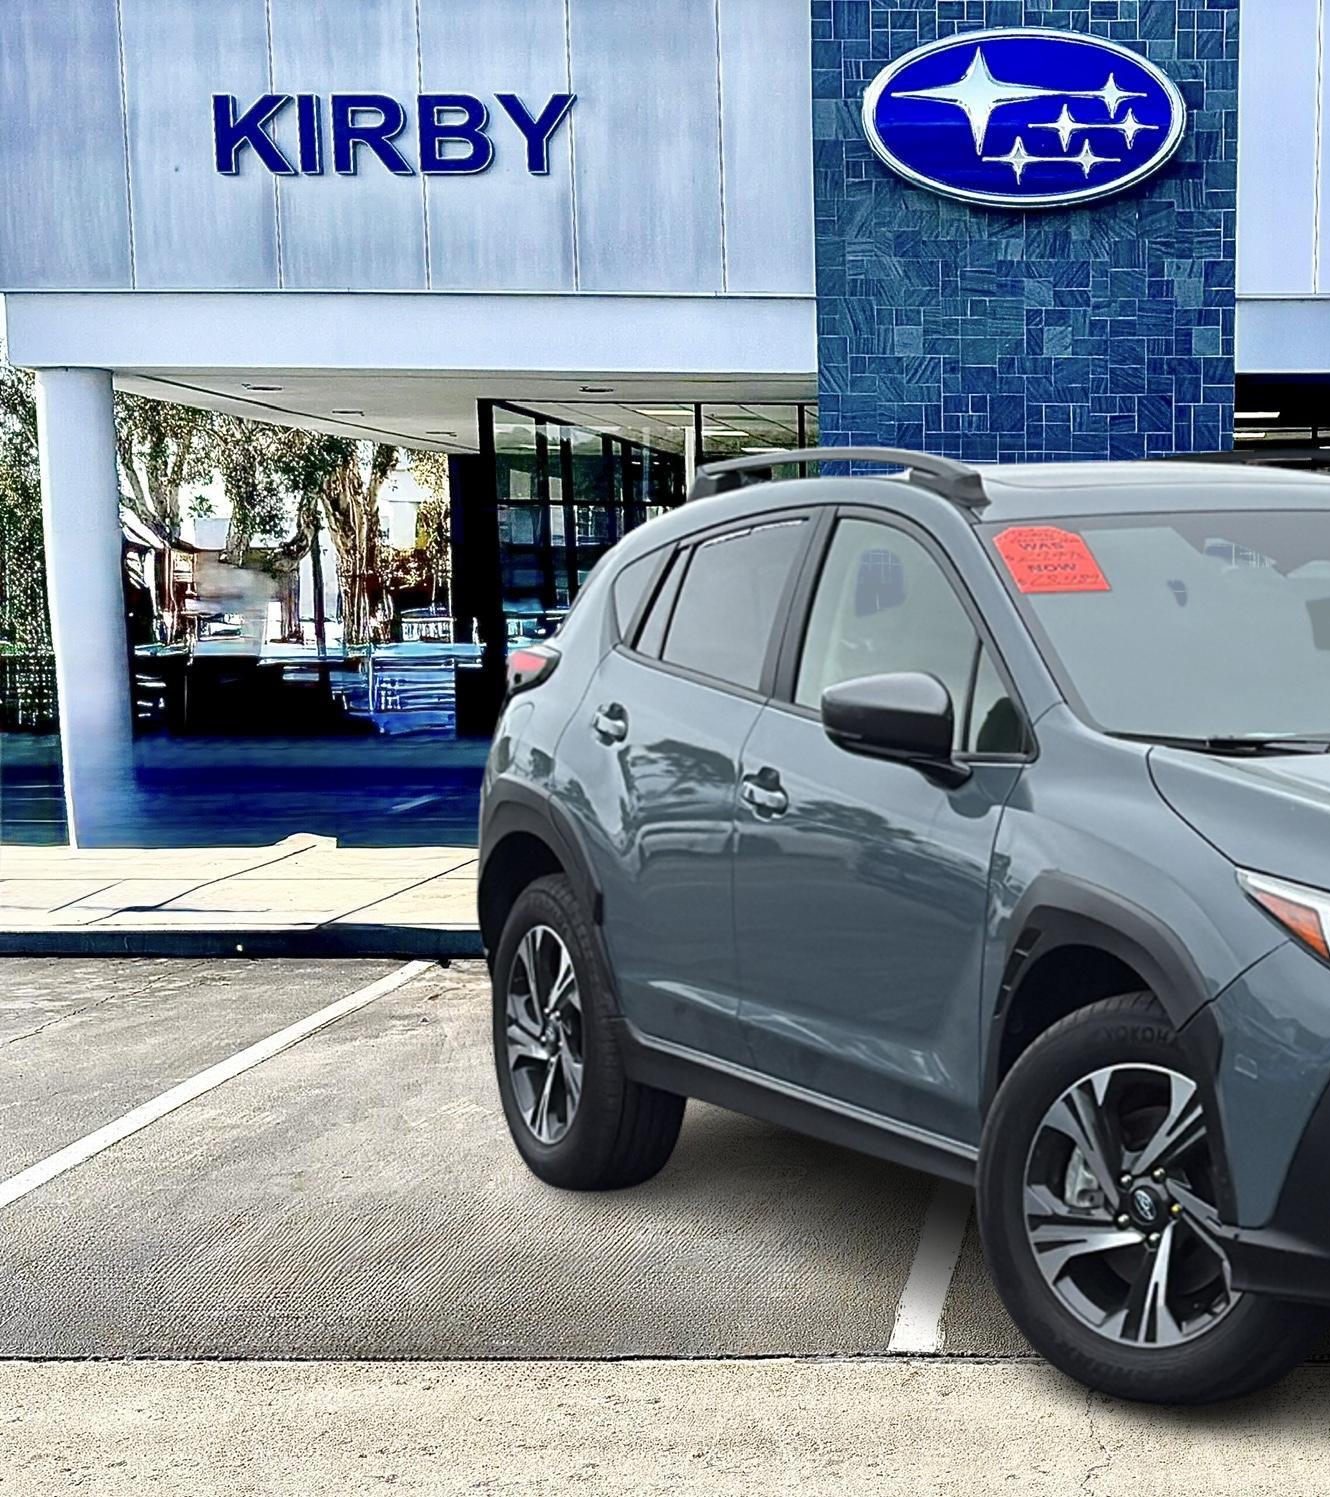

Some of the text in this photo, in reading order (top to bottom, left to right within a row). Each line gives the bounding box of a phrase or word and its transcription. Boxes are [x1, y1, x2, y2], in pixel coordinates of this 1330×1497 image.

[211, 93, 578, 176] KIRBY
[1018, 542, 1064, 551] WAS
[1027, 563, 1076, 573] NOW
